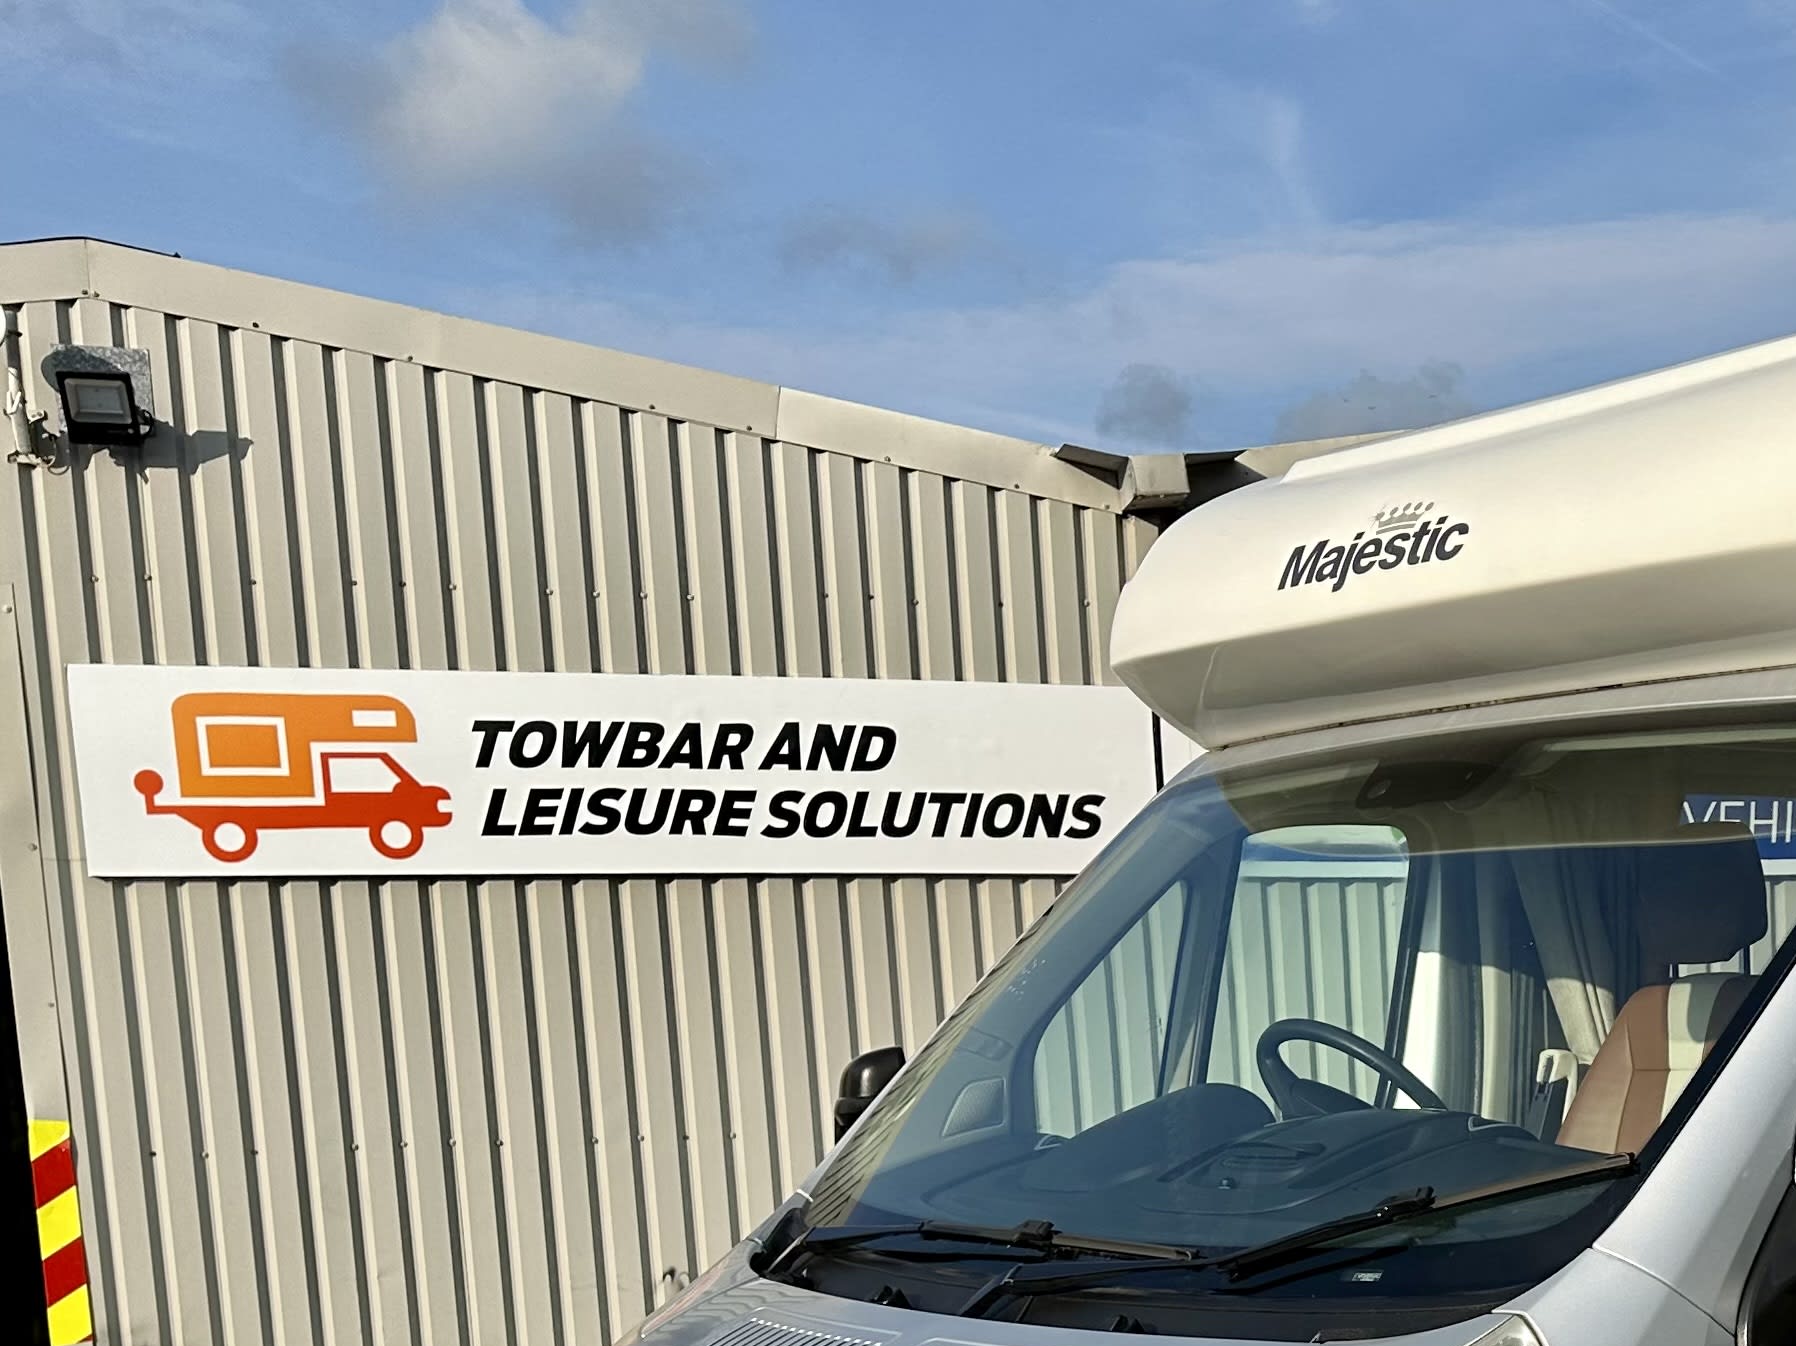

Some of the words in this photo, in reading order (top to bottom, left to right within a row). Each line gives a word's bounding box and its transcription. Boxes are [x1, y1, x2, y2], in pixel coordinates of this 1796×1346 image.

[1277, 516, 1469, 592] Majestic
[471, 720, 754, 769] TOWBAR
[758, 722, 897, 771] AND
[481, 787, 757, 836] LEISURE
[760, 790, 1106, 839] SOLUTIONS
